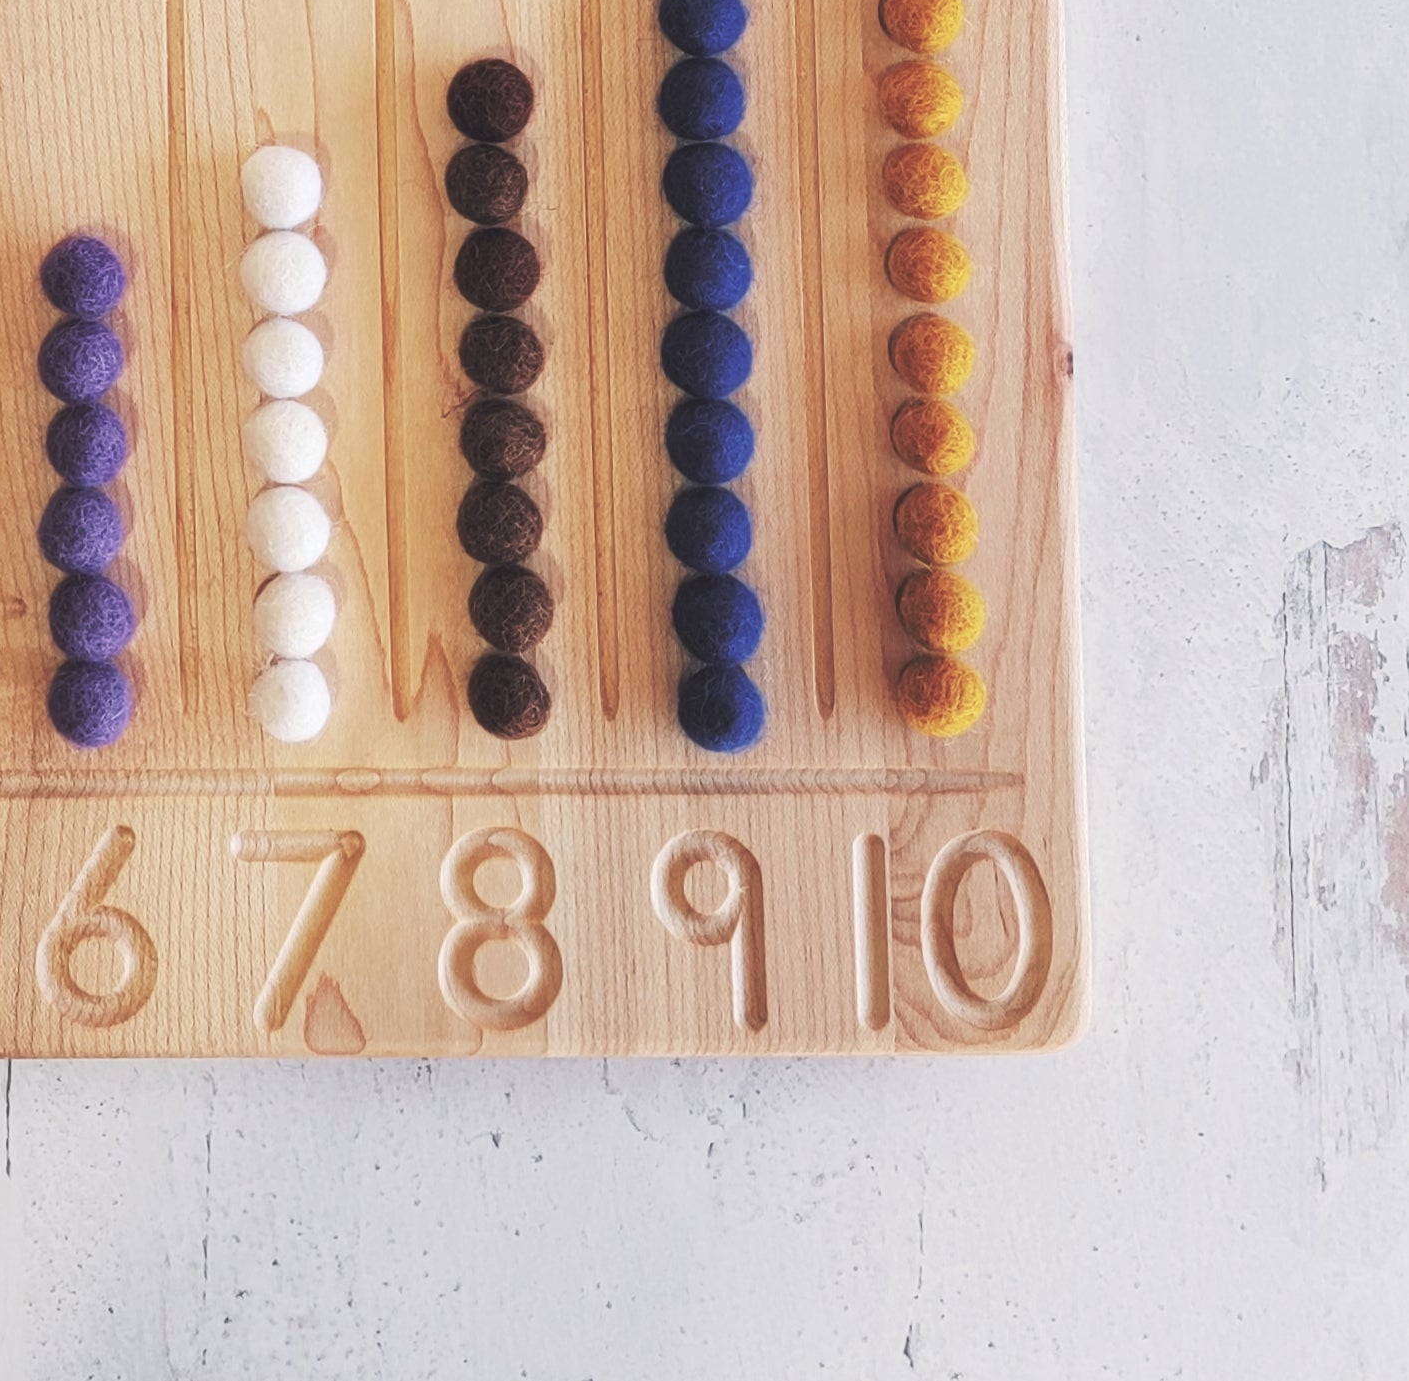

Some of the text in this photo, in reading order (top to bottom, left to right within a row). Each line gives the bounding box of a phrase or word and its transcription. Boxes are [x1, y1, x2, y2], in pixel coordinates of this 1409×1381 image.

[35, 825, 157, 1028] 6
[229, 830, 366, 1033] 7
[438, 826, 563, 1031] 8
[650, 828, 767, 1033] 9
[852, 827, 1054, 1033] 10
